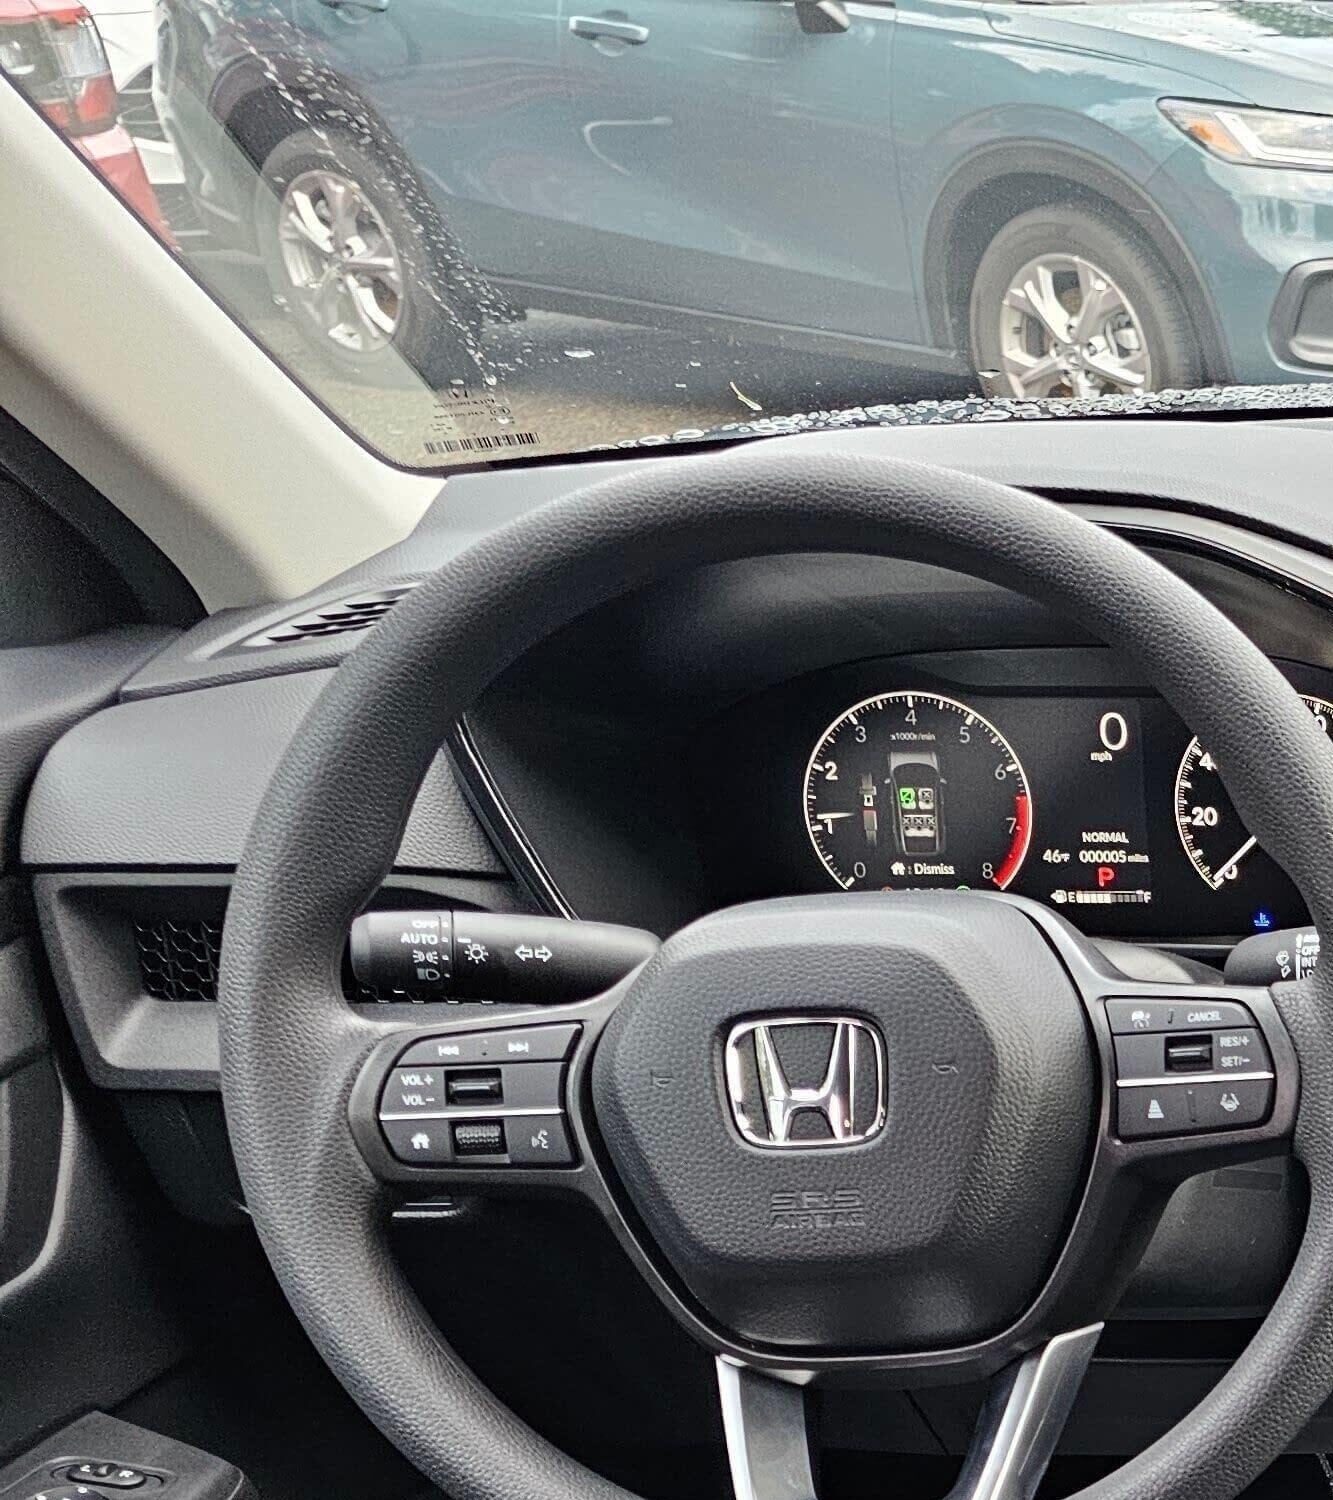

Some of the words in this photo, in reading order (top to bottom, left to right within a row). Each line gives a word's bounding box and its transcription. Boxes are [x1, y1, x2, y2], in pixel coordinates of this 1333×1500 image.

[905, 709, 918, 726] 4
[855, 726, 867, 743] 3
[959, 726, 971, 744] 5
[1099, 712, 1128, 751] 0
[1091, 752, 1112, 763] mph
[825, 761, 838, 780] 2
[995, 763, 1006, 780] 6
[1192, 806, 1218, 827] 20
[1005, 817, 1017, 834] 7
[1082, 832, 1129, 844] NORMAL
[1079, 850, 1127, 864] 000005
[854, 862, 866, 878] 0
[914, 863, 955, 875] Dismiss
[982, 863, 993, 879] 8
[1098, 867, 1115, 887] P
[400, 932, 438, 945] AUTO
[1187, 1011, 1222, 1023] CANCEL
